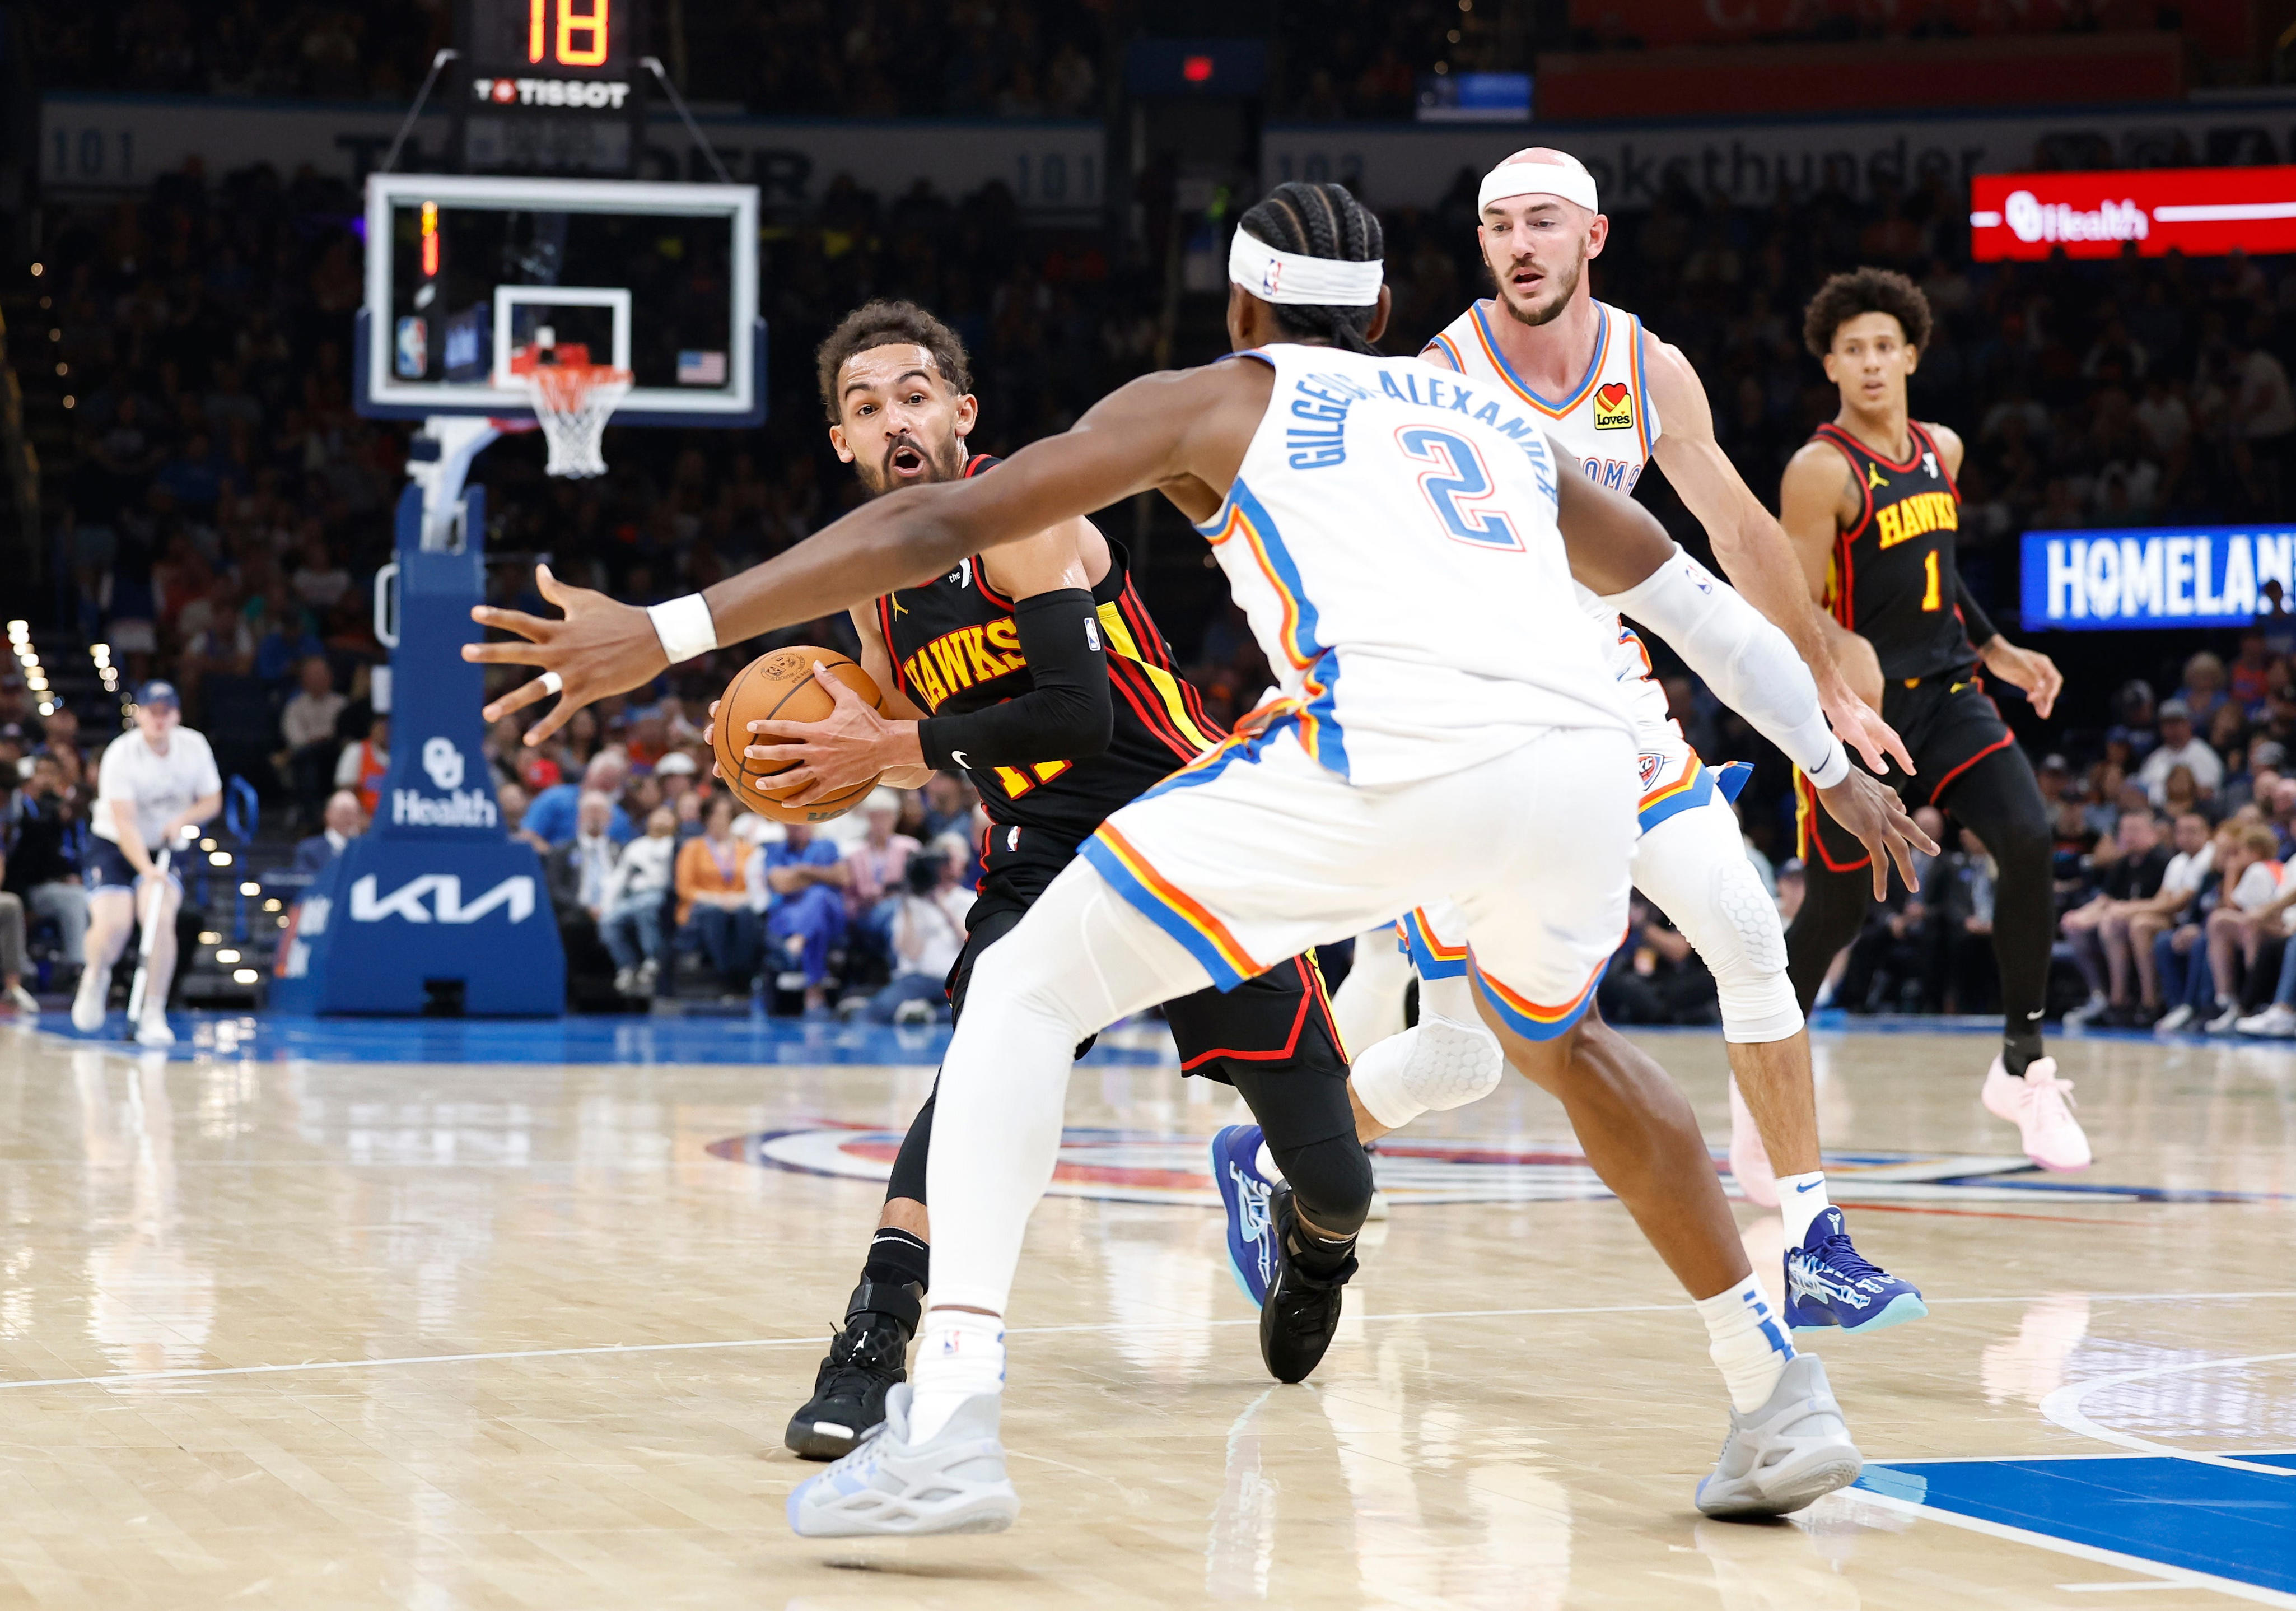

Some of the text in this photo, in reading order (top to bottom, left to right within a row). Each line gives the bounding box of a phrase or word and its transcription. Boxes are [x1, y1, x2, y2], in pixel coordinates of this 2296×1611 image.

[529, 0, 609, 67] 18
[1394, 423, 1527, 552] 2
[949, 572, 960, 583] the
[1921, 548, 1942, 612] 1
[2047, 533, 2296, 621] HOMELAN
[903, 616, 1028, 716] HAWKS
[393, 788, 498, 828] Health
